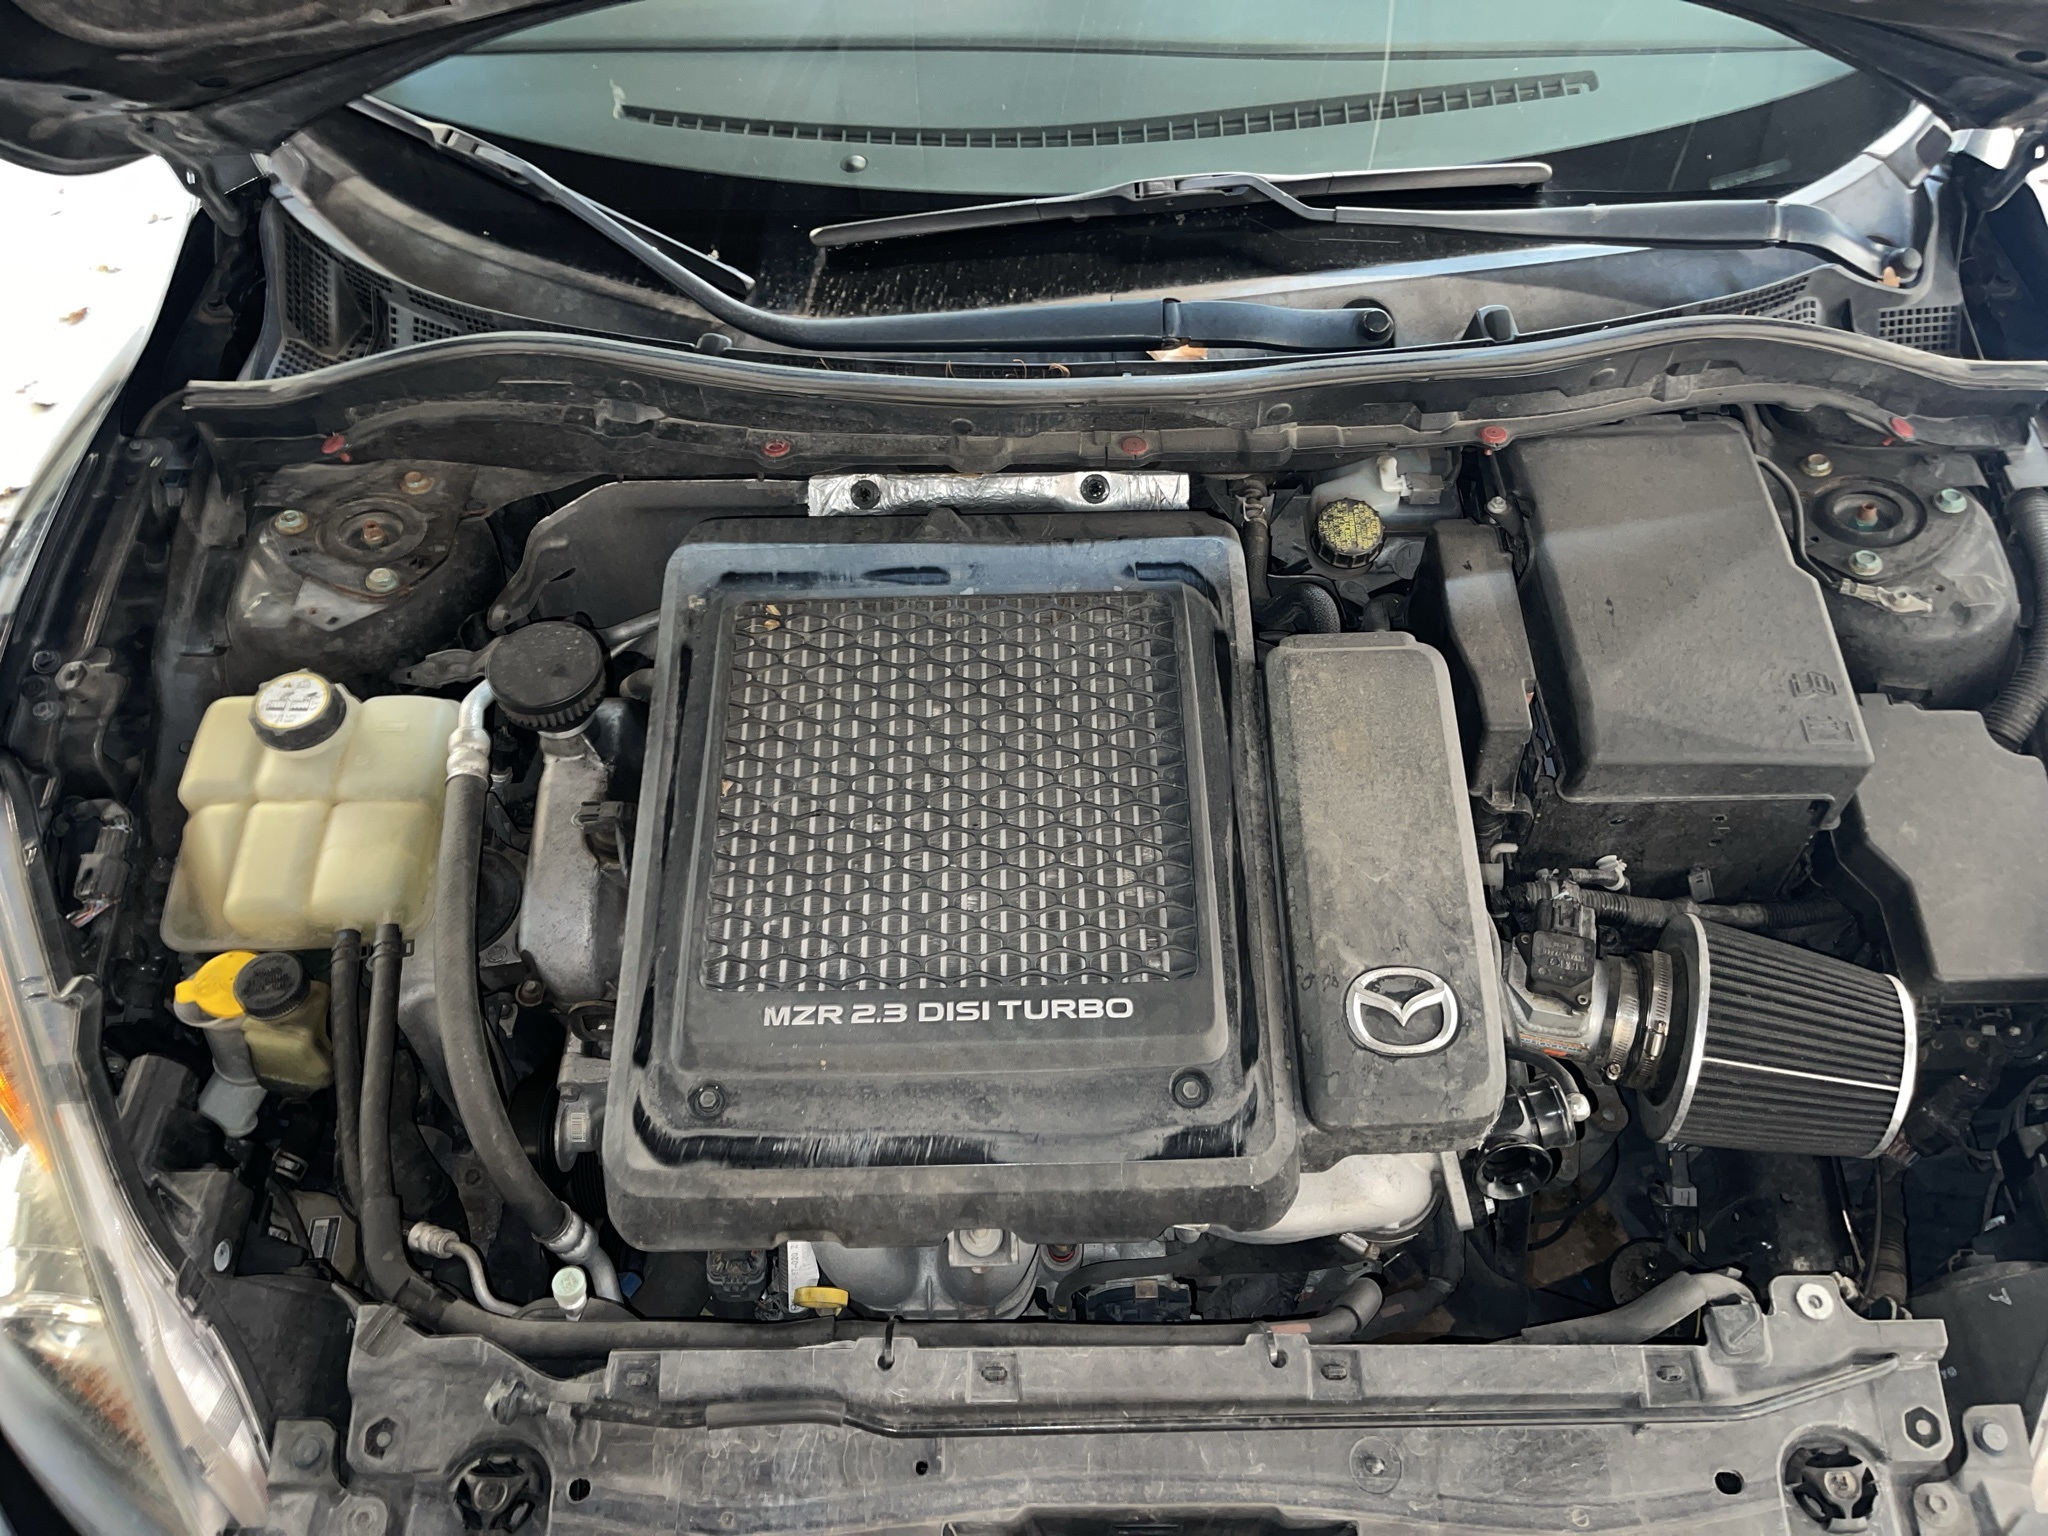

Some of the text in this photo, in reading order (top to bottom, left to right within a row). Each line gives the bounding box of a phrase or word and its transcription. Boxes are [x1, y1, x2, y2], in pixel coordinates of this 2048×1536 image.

[763, 997, 1134, 1027] MZR 2.3 DISI TURBO
